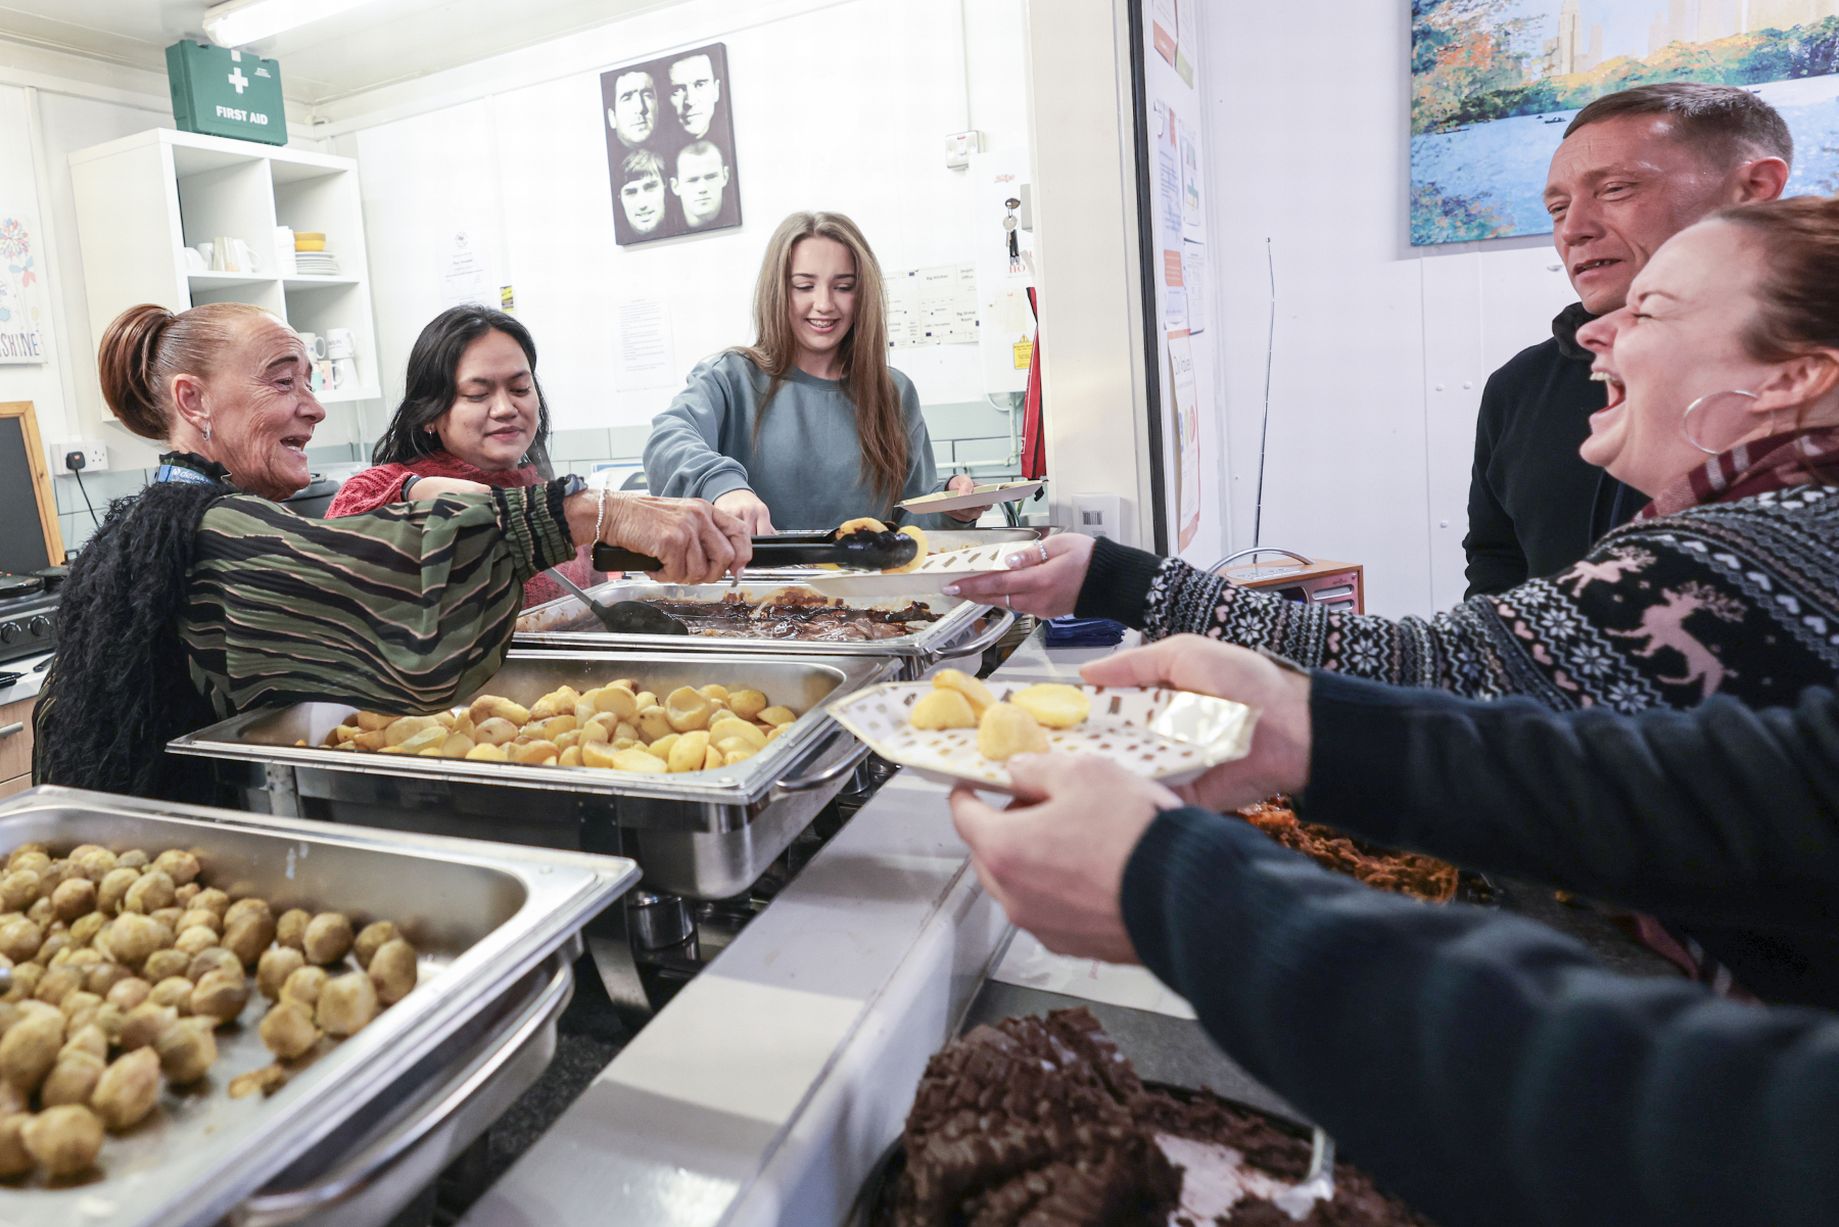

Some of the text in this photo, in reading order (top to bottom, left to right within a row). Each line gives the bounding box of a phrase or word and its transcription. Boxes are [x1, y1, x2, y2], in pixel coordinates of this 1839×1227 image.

[216, 105, 268, 125] FIRST AID
[0, 332, 40, 358] SHINE
